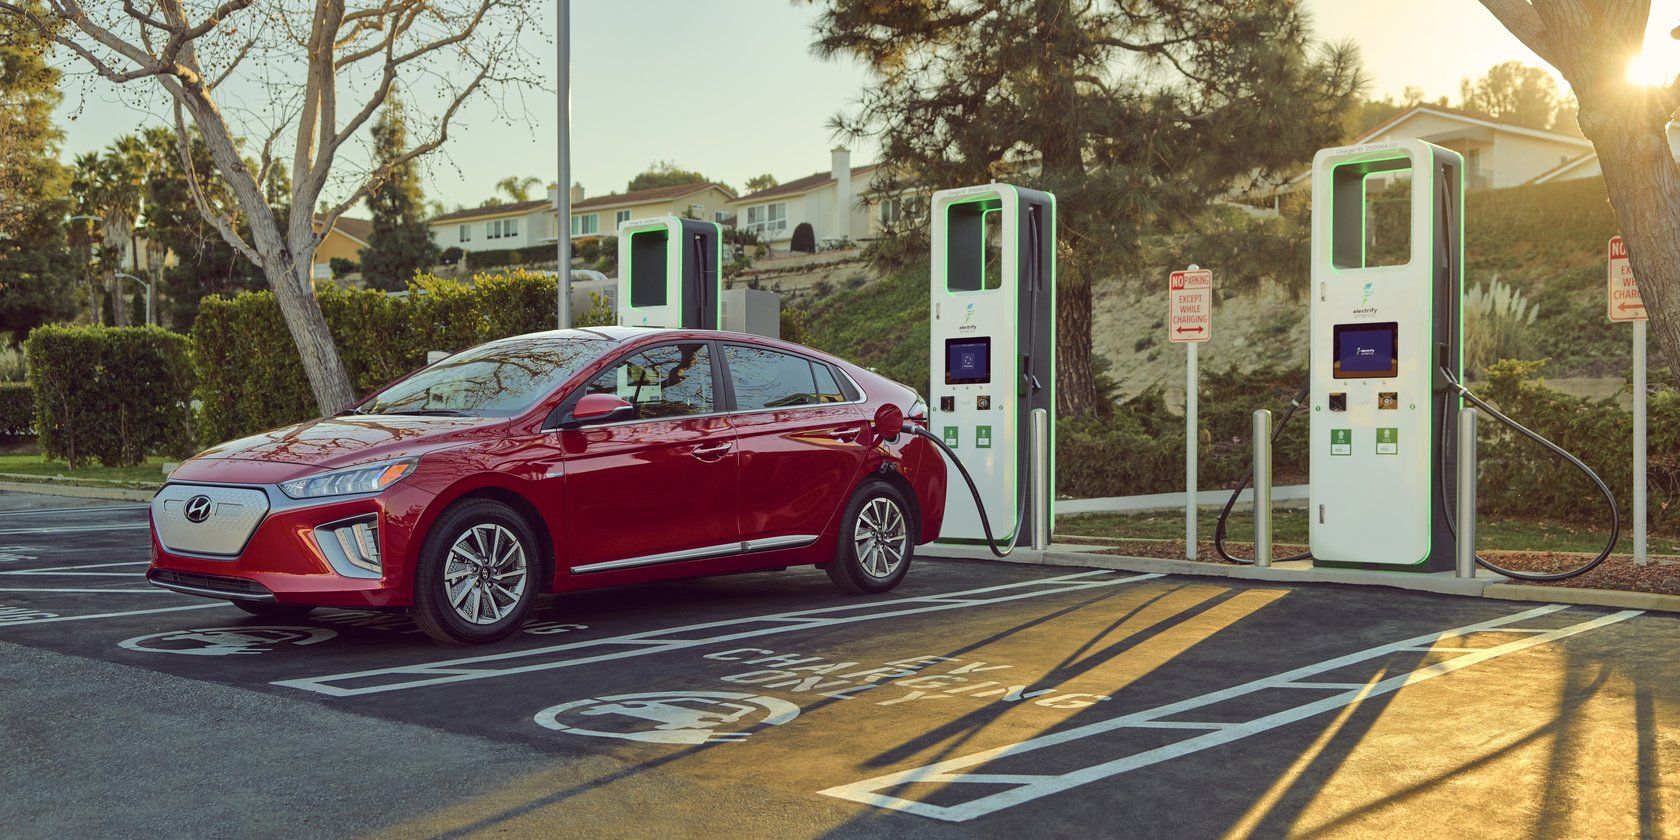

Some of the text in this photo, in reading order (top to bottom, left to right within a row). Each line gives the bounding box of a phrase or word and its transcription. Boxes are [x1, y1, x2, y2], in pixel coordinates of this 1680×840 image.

[1172, 275, 1209, 288] NO PARKING
[1179, 294, 1202, 303] EXCEPT
[1181, 305, 1201, 313] WHILE
[1174, 315, 1207, 324] CHARGING
[702, 647, 1112, 709] CHARGING
[720, 669, 954, 707] ONLY
